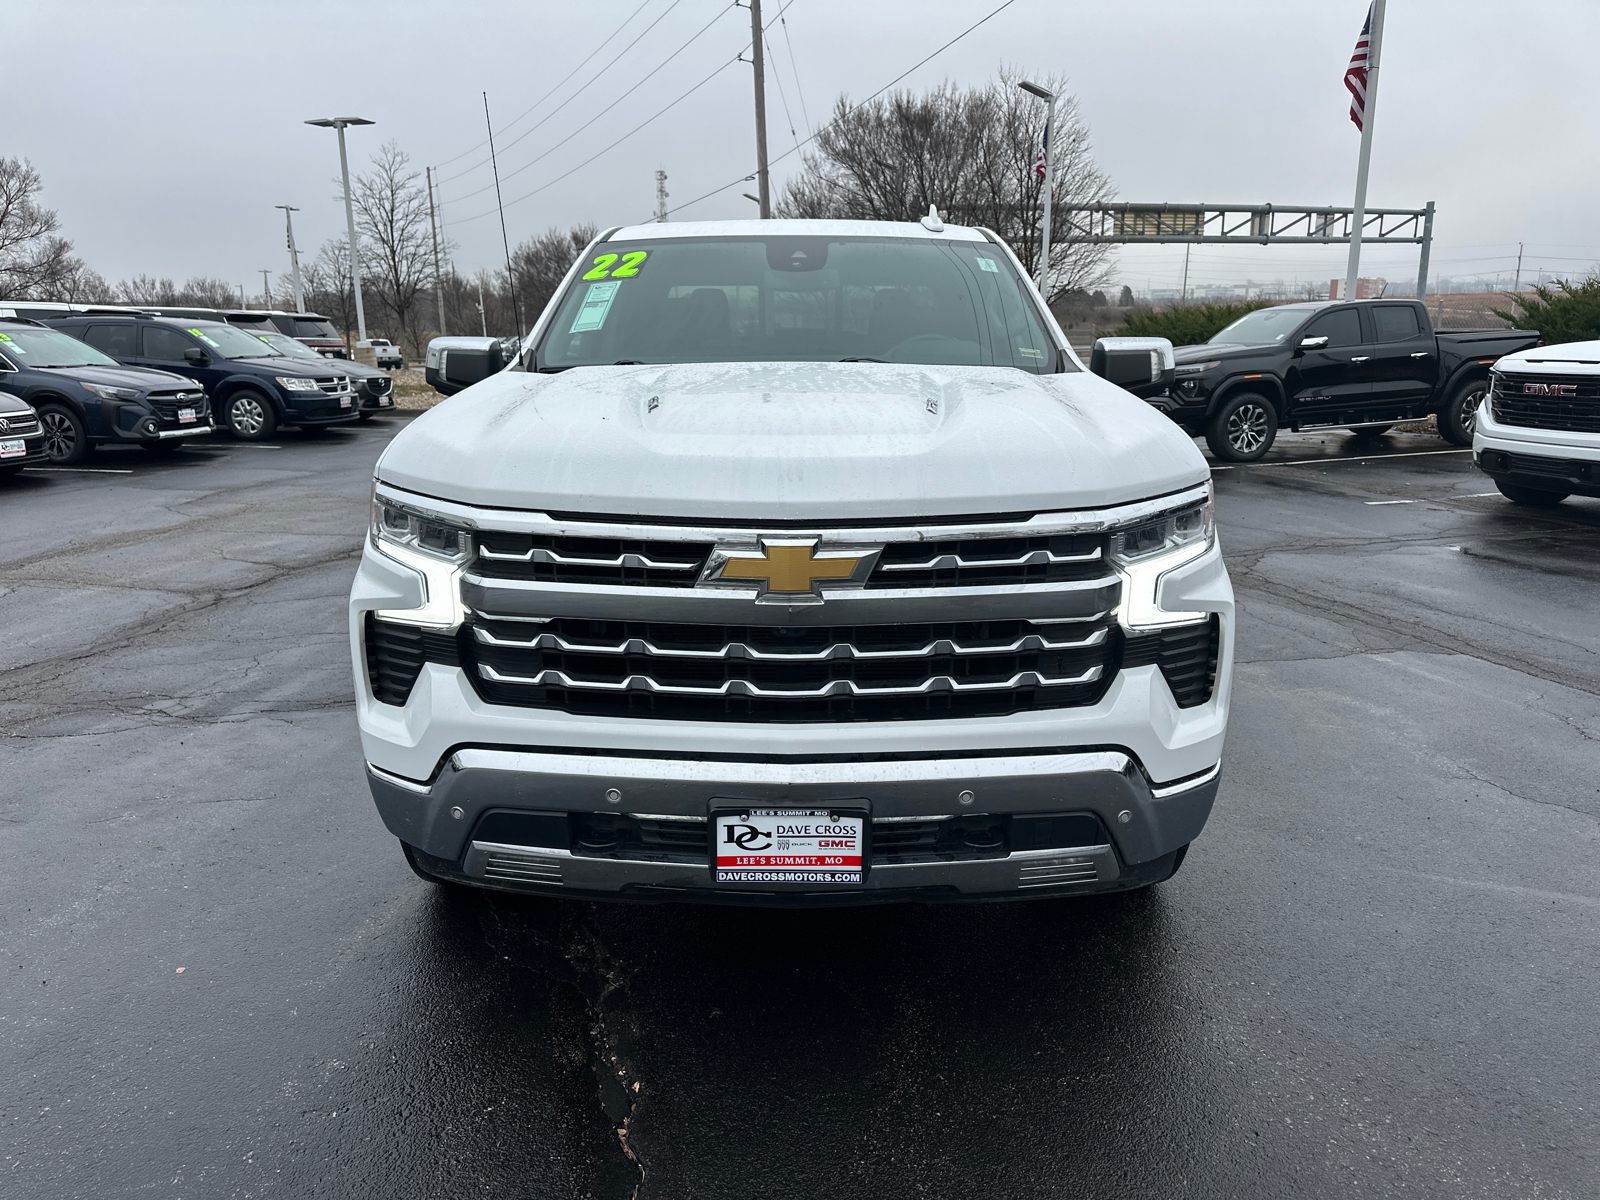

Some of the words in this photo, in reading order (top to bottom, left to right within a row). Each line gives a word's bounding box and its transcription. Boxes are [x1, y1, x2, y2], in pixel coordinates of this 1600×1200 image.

[583, 251, 647, 280] 22
[1523, 383, 1577, 397] GMC
[776, 825, 811, 835] DAVE
[815, 825, 857, 835] CROSS
[818, 840, 856, 848] GMC
[736, 857, 766, 865] LEE'S
[770, 857, 821, 866] SUMMIT,
[824, 856, 843, 865] MO
[718, 872, 860, 882] DAVECROSSMOTORS.COM
